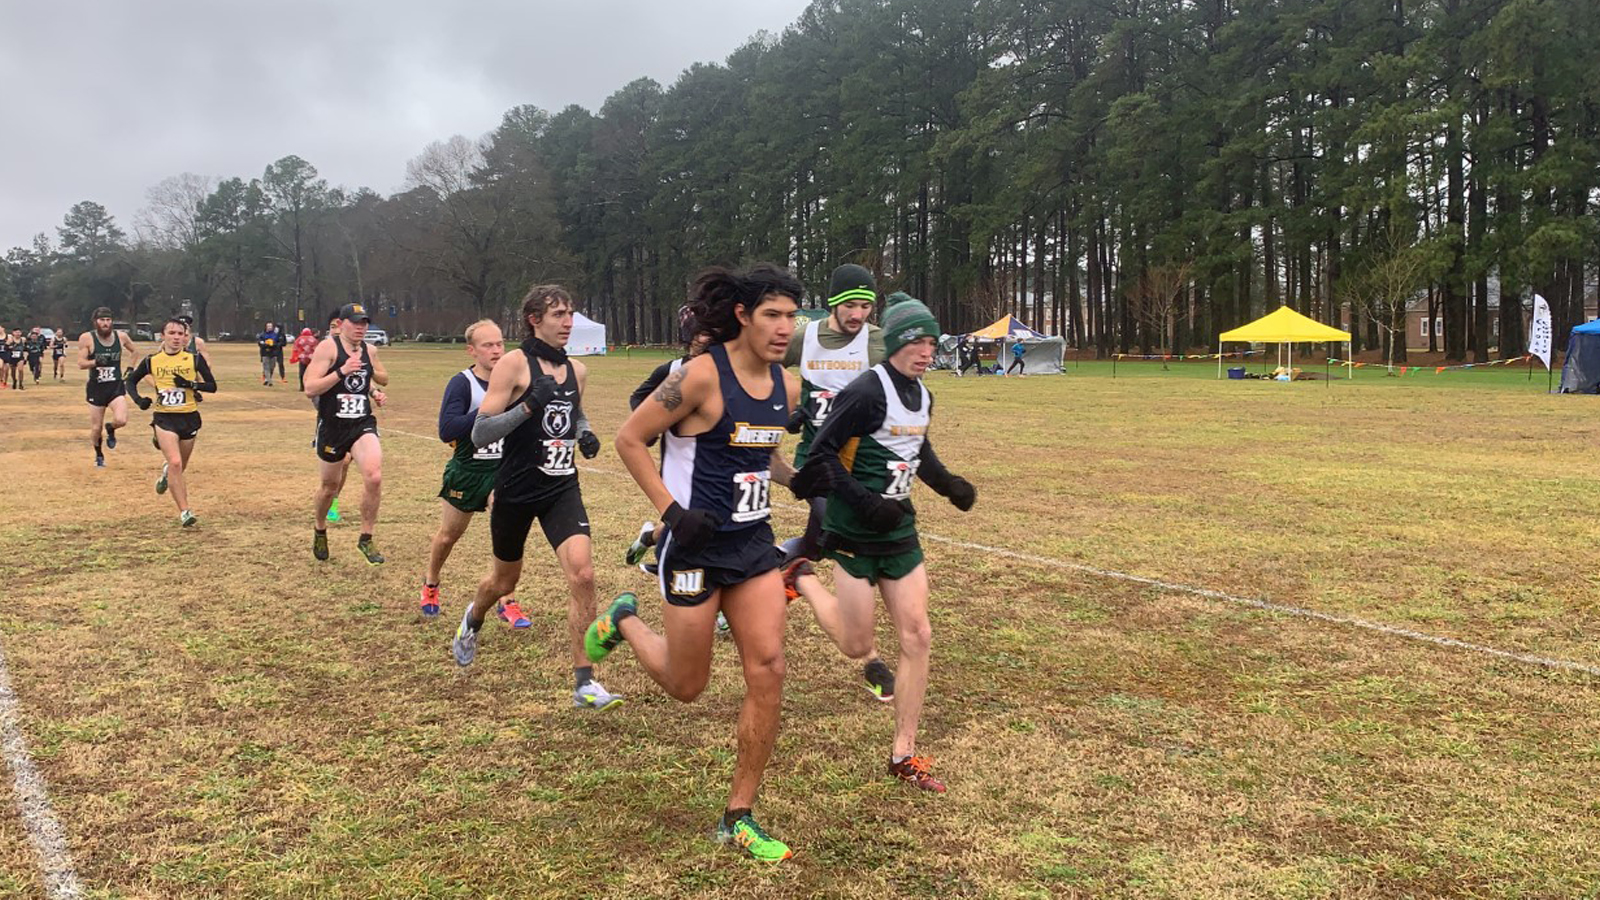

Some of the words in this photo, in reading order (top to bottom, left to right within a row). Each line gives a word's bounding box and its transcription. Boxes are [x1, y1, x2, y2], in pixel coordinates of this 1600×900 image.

[806, 360, 862, 370] METHODIST
[161, 392, 184, 405] 269
[340, 399, 365, 414] 334
[543, 446, 574, 469] 323
[737, 480, 769, 512] 213
[672, 570, 704, 594] AU
